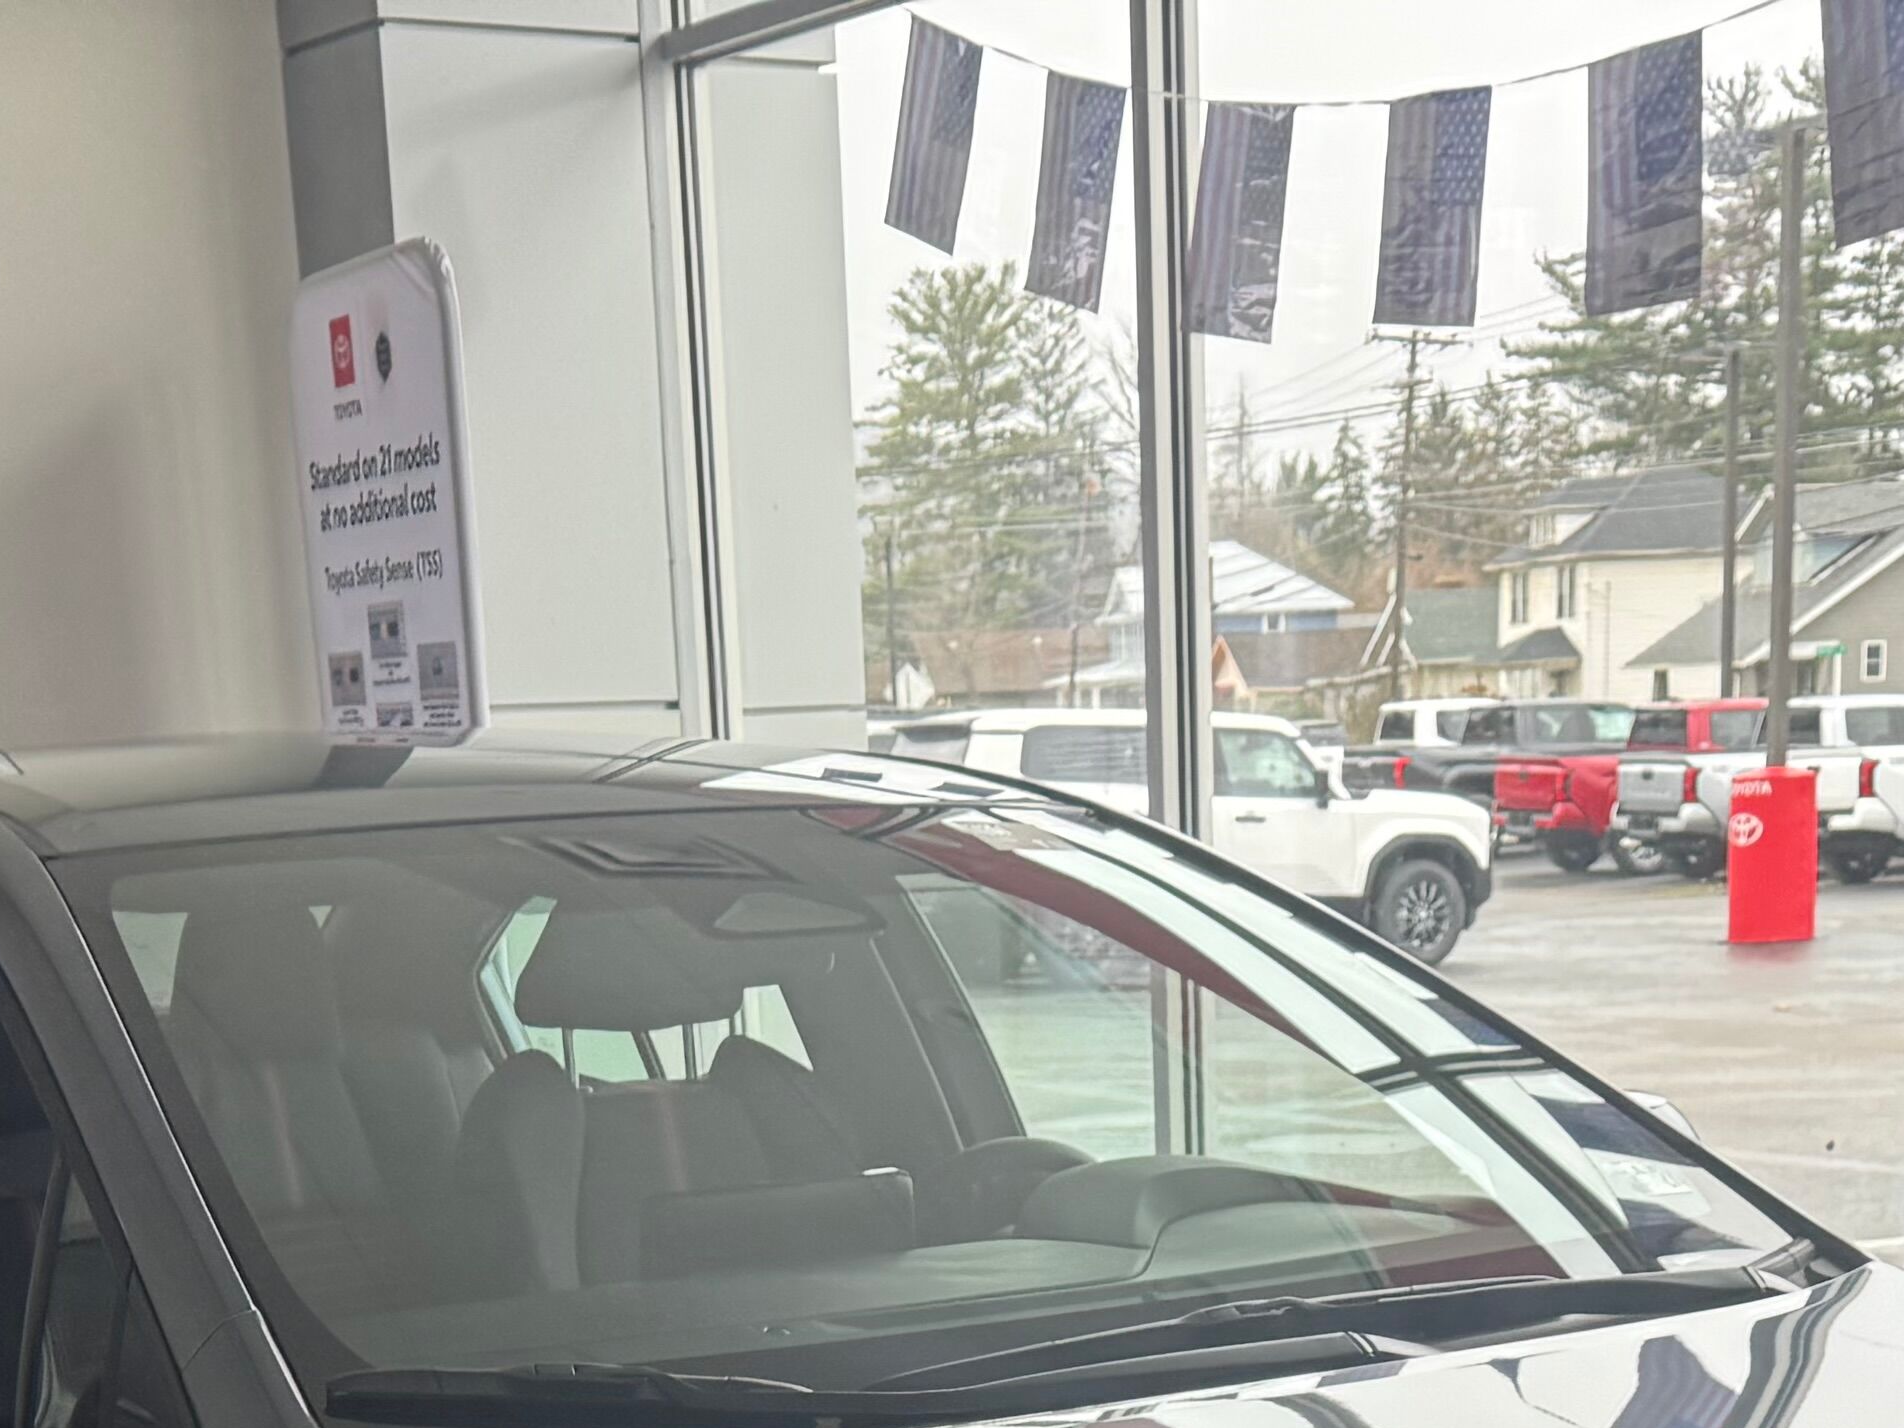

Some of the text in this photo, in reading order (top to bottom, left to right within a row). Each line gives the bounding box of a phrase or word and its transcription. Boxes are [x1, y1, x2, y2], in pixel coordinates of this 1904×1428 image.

[309, 431, 440, 491] Standard on 21 models
[321, 481, 437, 533] at no additional cost
[325, 548, 444, 595] Toyota Safety Sense (TSS)
